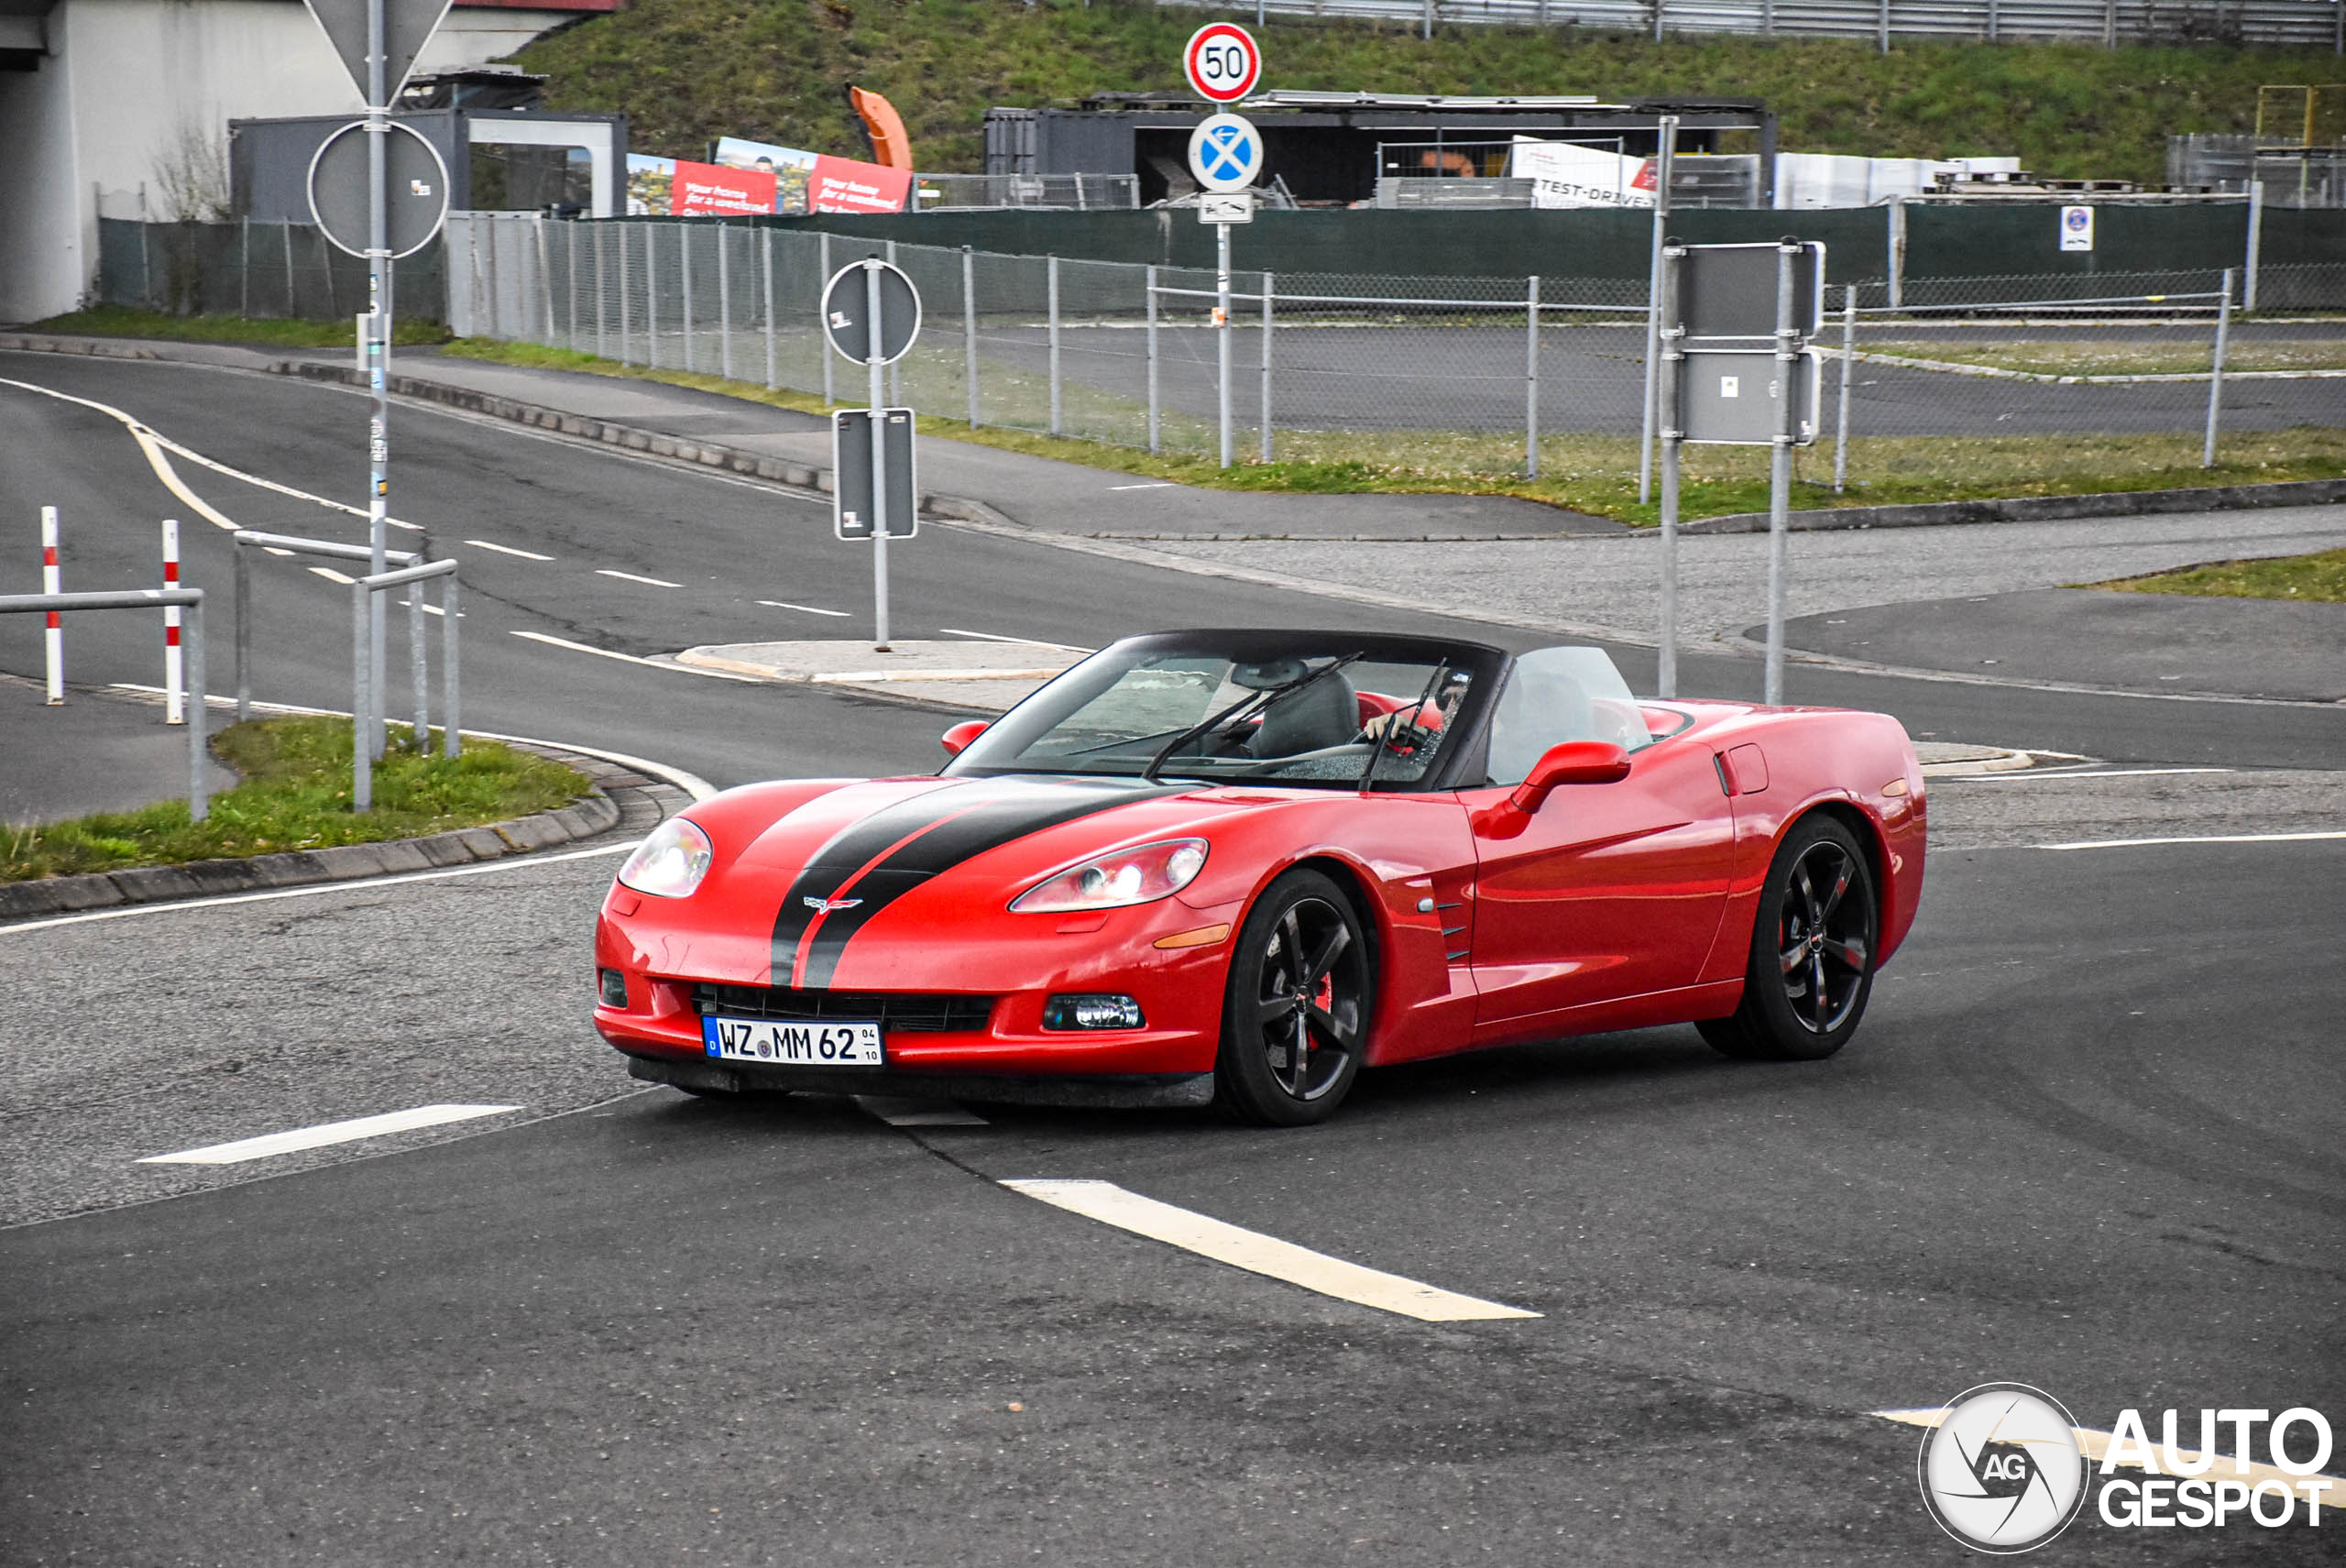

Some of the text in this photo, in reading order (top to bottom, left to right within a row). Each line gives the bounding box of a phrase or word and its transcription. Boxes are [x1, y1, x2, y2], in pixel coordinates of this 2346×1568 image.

[1205, 46, 1243, 80] 50
[861, 1028, 875, 1038] 04
[709, 1041, 717, 1050] D
[719, 1023, 857, 1059] WZ MM 62
[865, 1051, 878, 1060] 10
